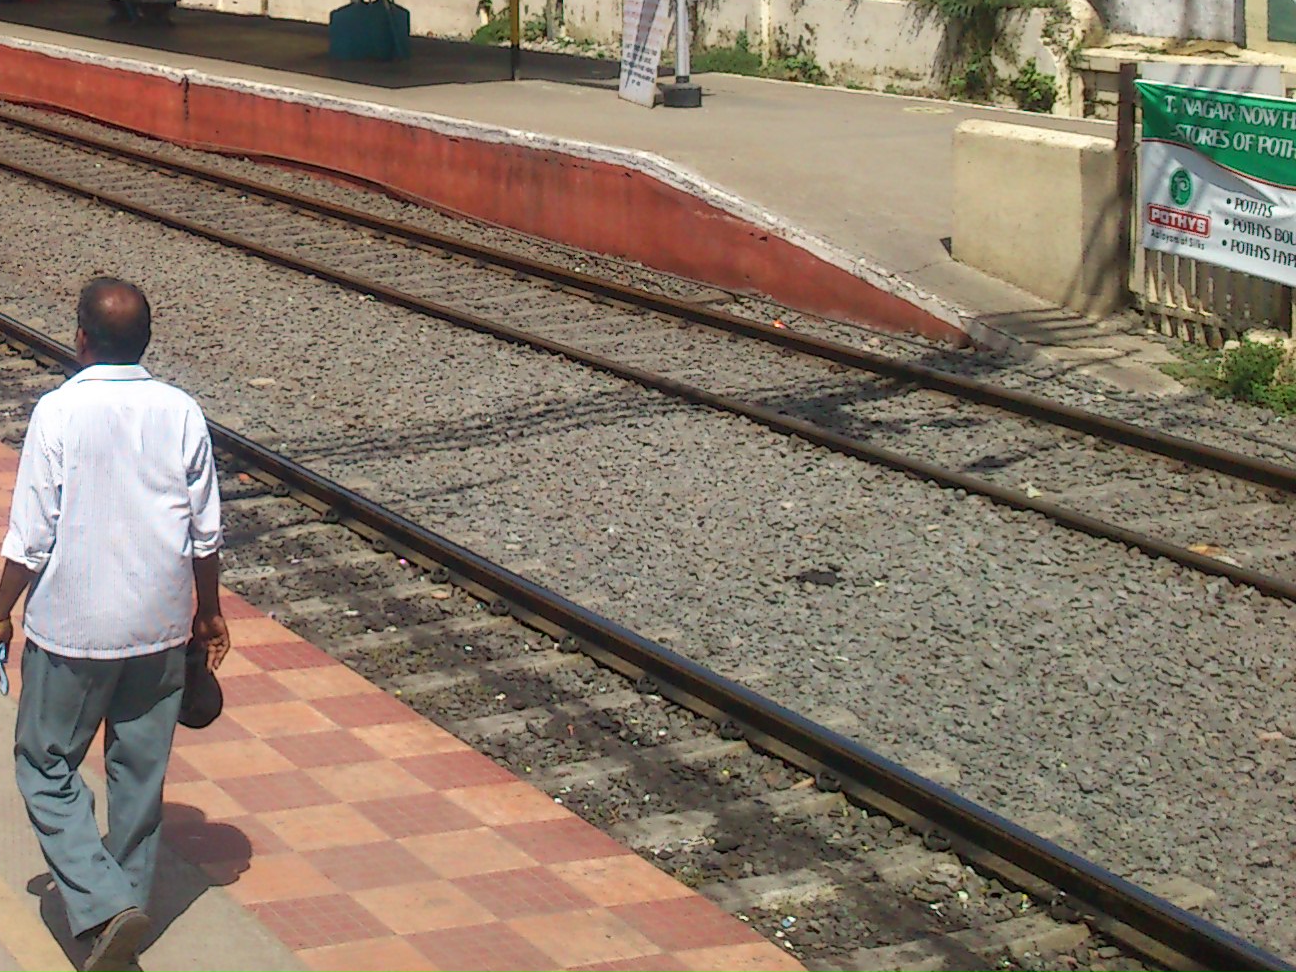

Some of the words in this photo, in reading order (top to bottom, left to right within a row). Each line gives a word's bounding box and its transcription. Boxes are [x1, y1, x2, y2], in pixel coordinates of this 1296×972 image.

[1164, 95, 1178, 115] T.
[1180, 97, 1236, 123] NAGAR
[1238, 106, 1281, 128] NOW
[1232, 131, 1256, 152] OF
[1151, 208, 1207, 233] POTHYS
